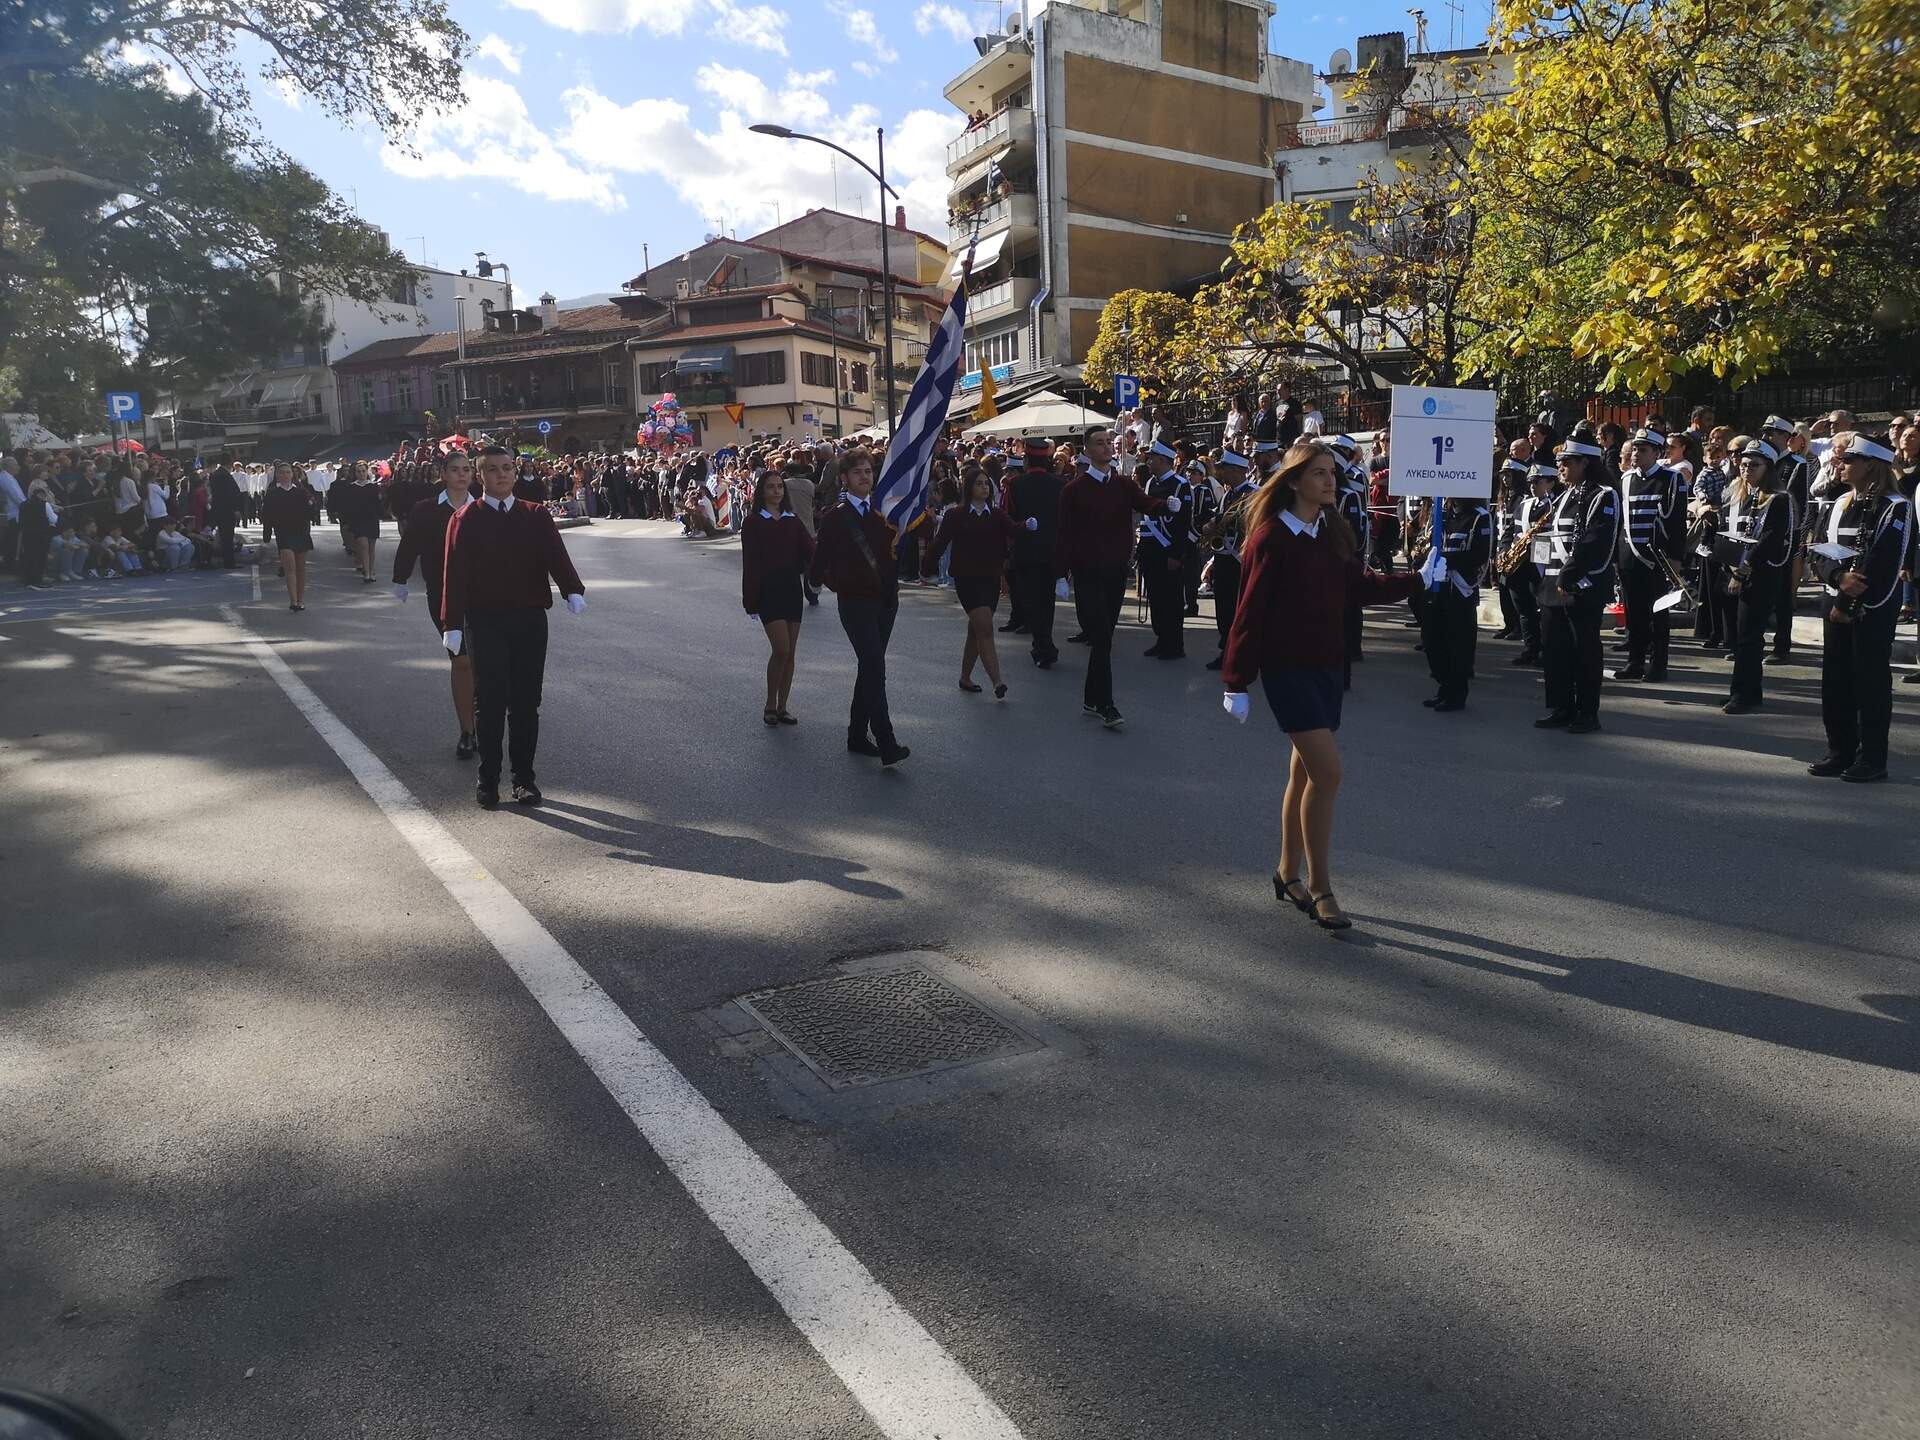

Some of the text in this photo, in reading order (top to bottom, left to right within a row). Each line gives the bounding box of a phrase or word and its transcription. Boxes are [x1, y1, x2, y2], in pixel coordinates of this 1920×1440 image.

[1120, 379, 1135, 403] P
[112, 396, 134, 418] P
[1405, 469, 1477, 480] ΛΥΚΕΙΟ ΝΑΟΥΣΑΣ
